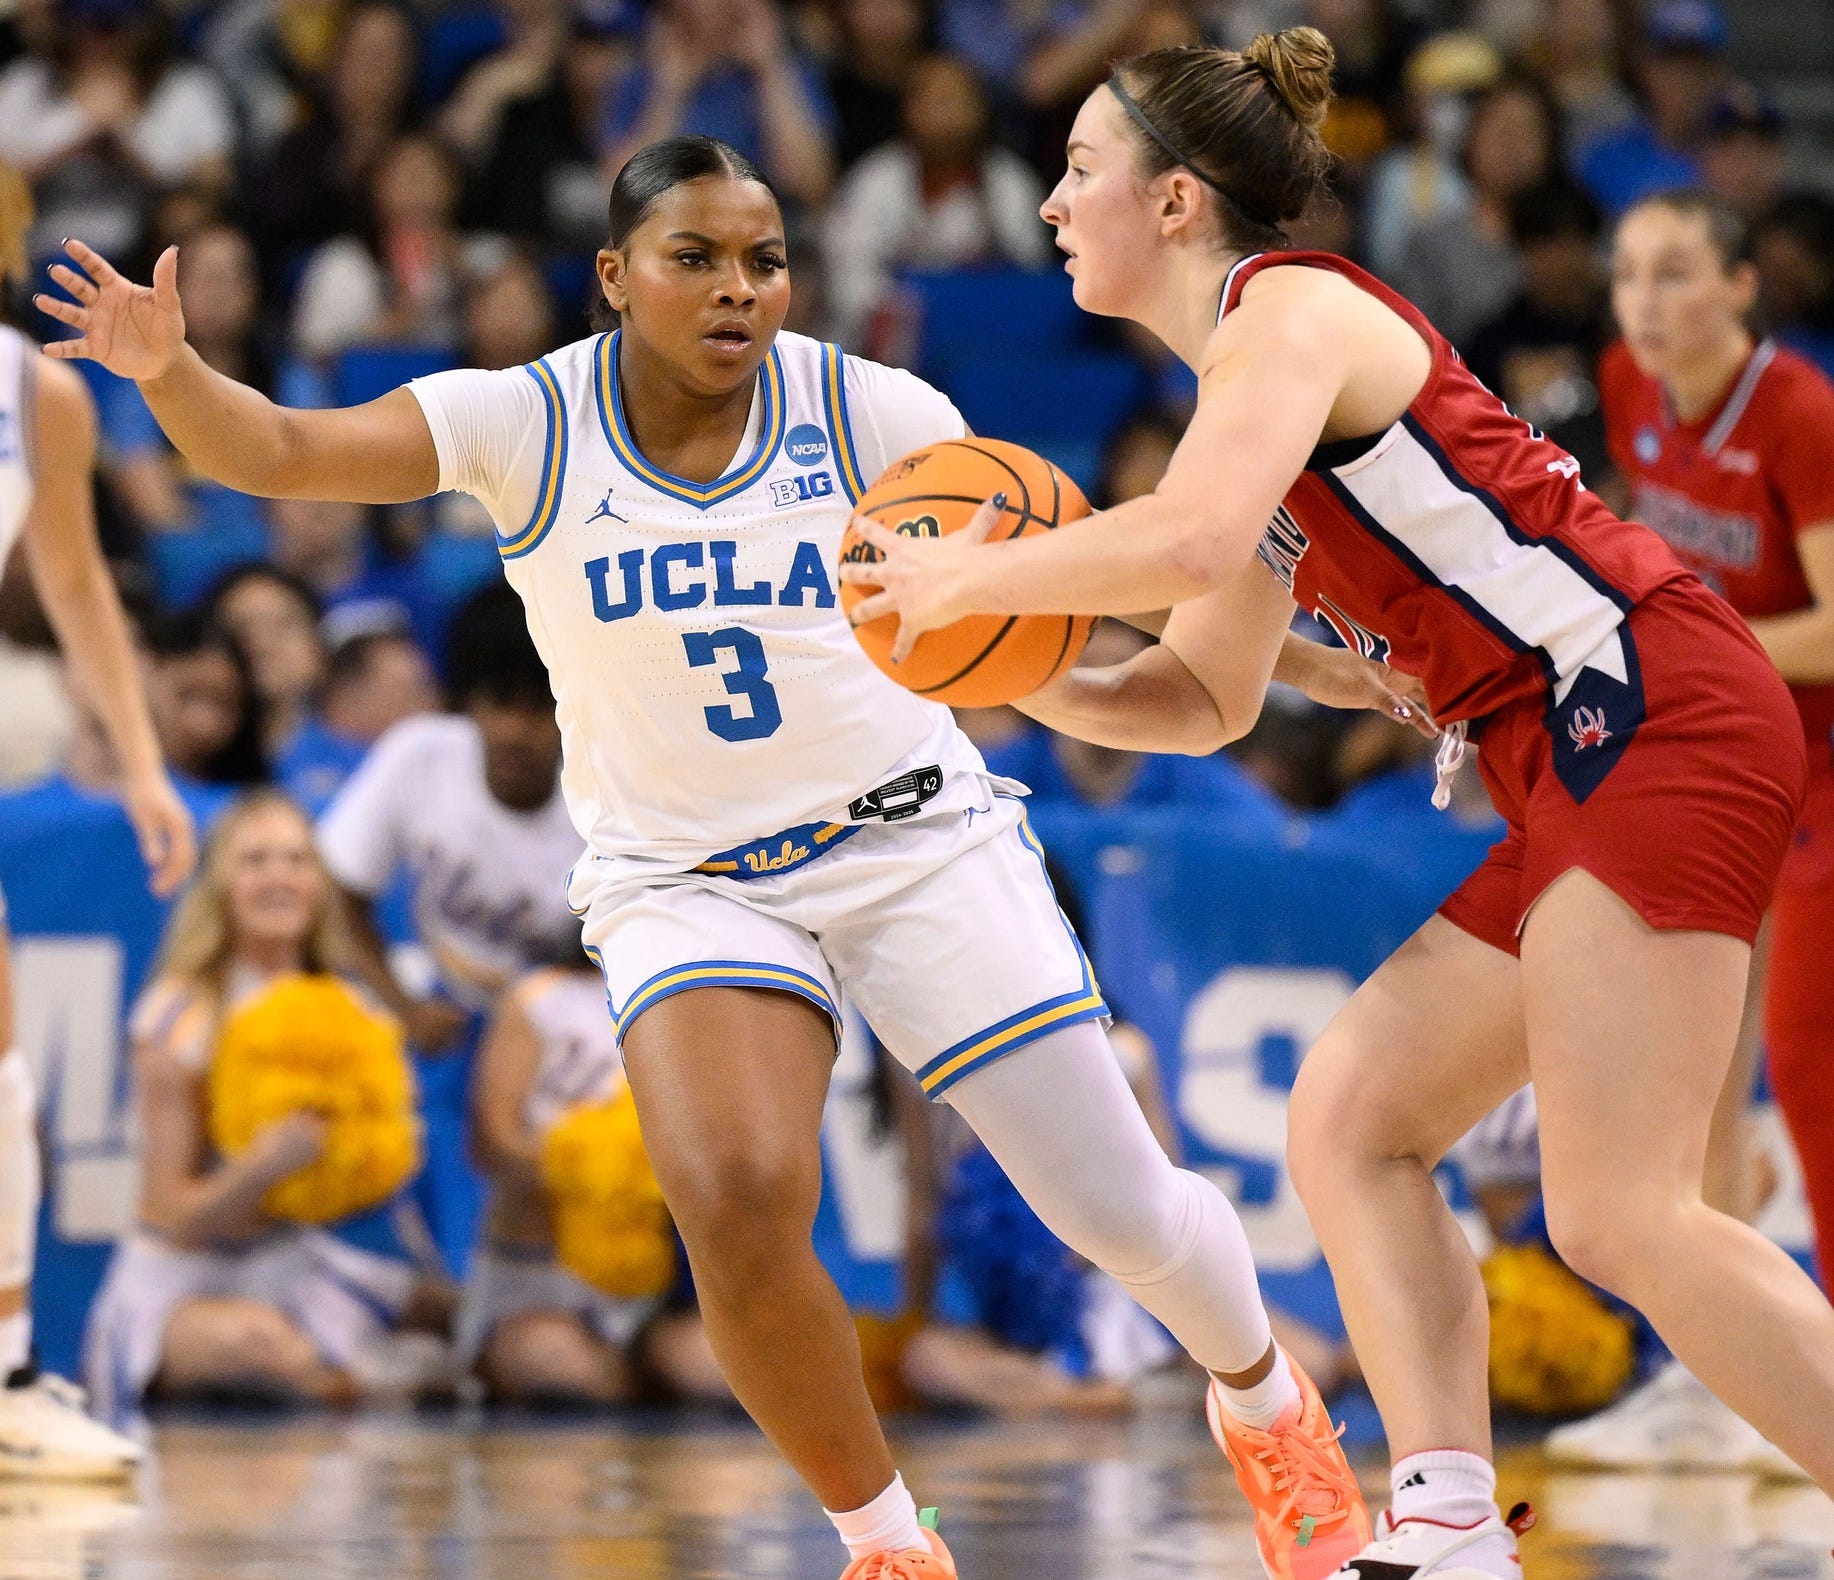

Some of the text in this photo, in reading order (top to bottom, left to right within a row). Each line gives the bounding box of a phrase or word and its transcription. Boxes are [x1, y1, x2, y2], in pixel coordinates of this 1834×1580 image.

[792, 442, 827, 456] NCAA
[584, 540, 837, 623] UCLA
[681, 626, 783, 743] 3
[923, 776, 937, 792] 42
